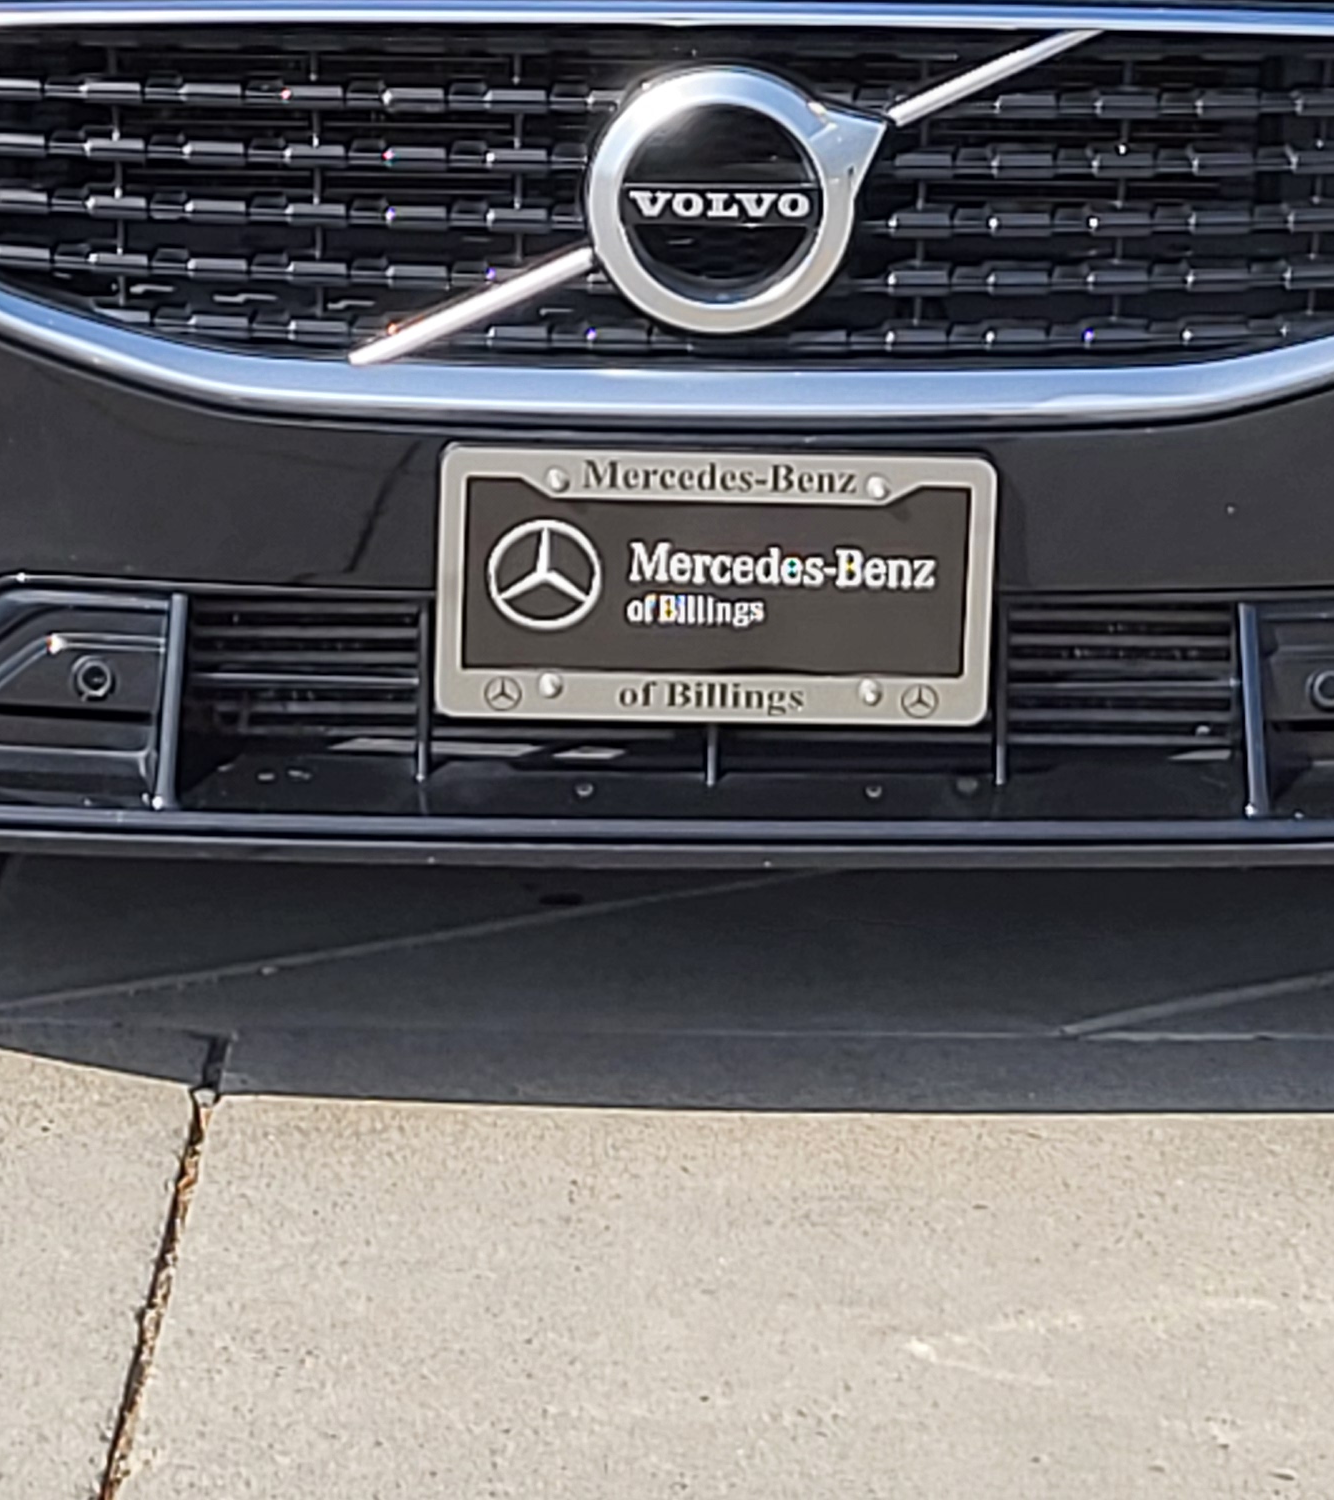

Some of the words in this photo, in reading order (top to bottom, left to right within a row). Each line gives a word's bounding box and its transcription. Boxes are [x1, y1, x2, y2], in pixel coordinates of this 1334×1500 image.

[629, 191, 810, 218] VOLVO
[582, 458, 858, 495] Mercedes-Benz
[629, 542, 936, 588] Mercedes-Benz
[626, 594, 657, 624] of
[658, 594, 765, 628] Billings
[618, 681, 658, 708] of
[666, 681, 805, 717] Billings
